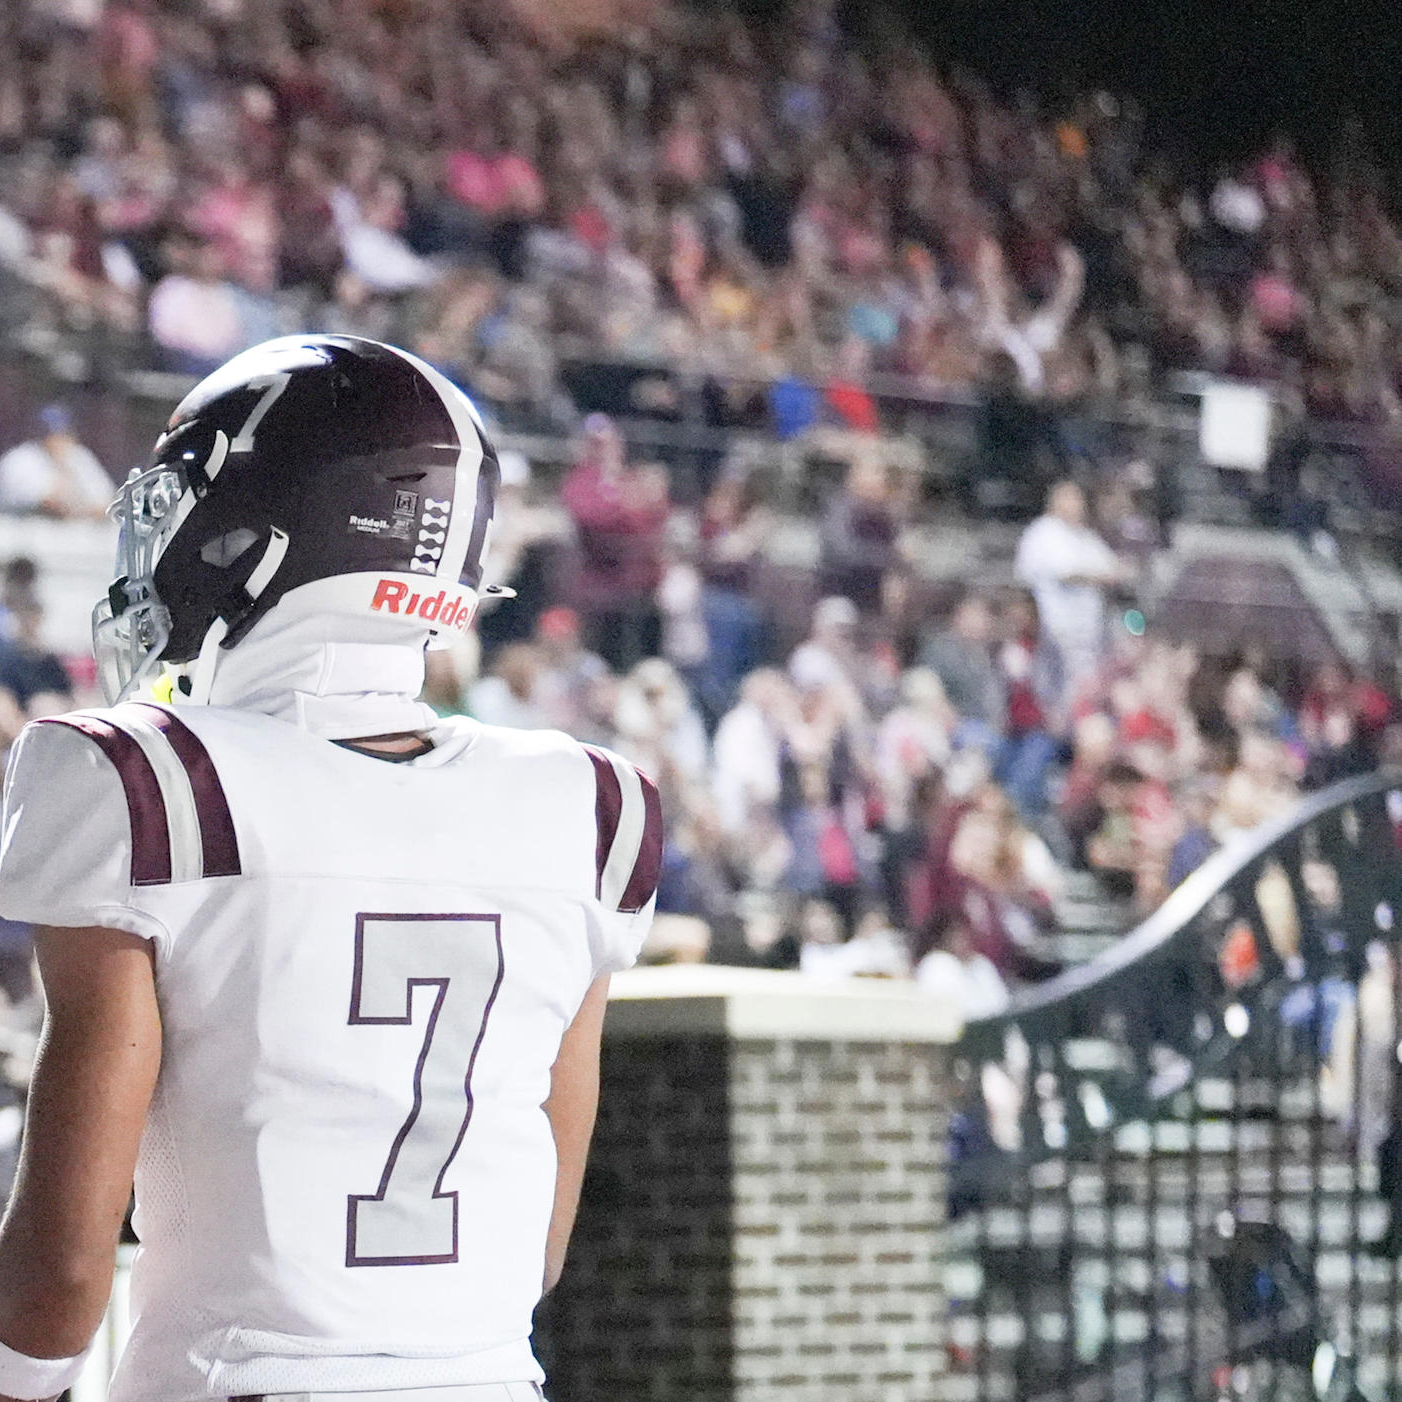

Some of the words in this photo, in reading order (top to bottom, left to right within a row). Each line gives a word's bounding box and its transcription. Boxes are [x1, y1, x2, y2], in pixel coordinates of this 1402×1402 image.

[228, 373, 293, 453] 7
[349, 515, 388, 528] Riddell
[346, 913, 504, 1267] 7
